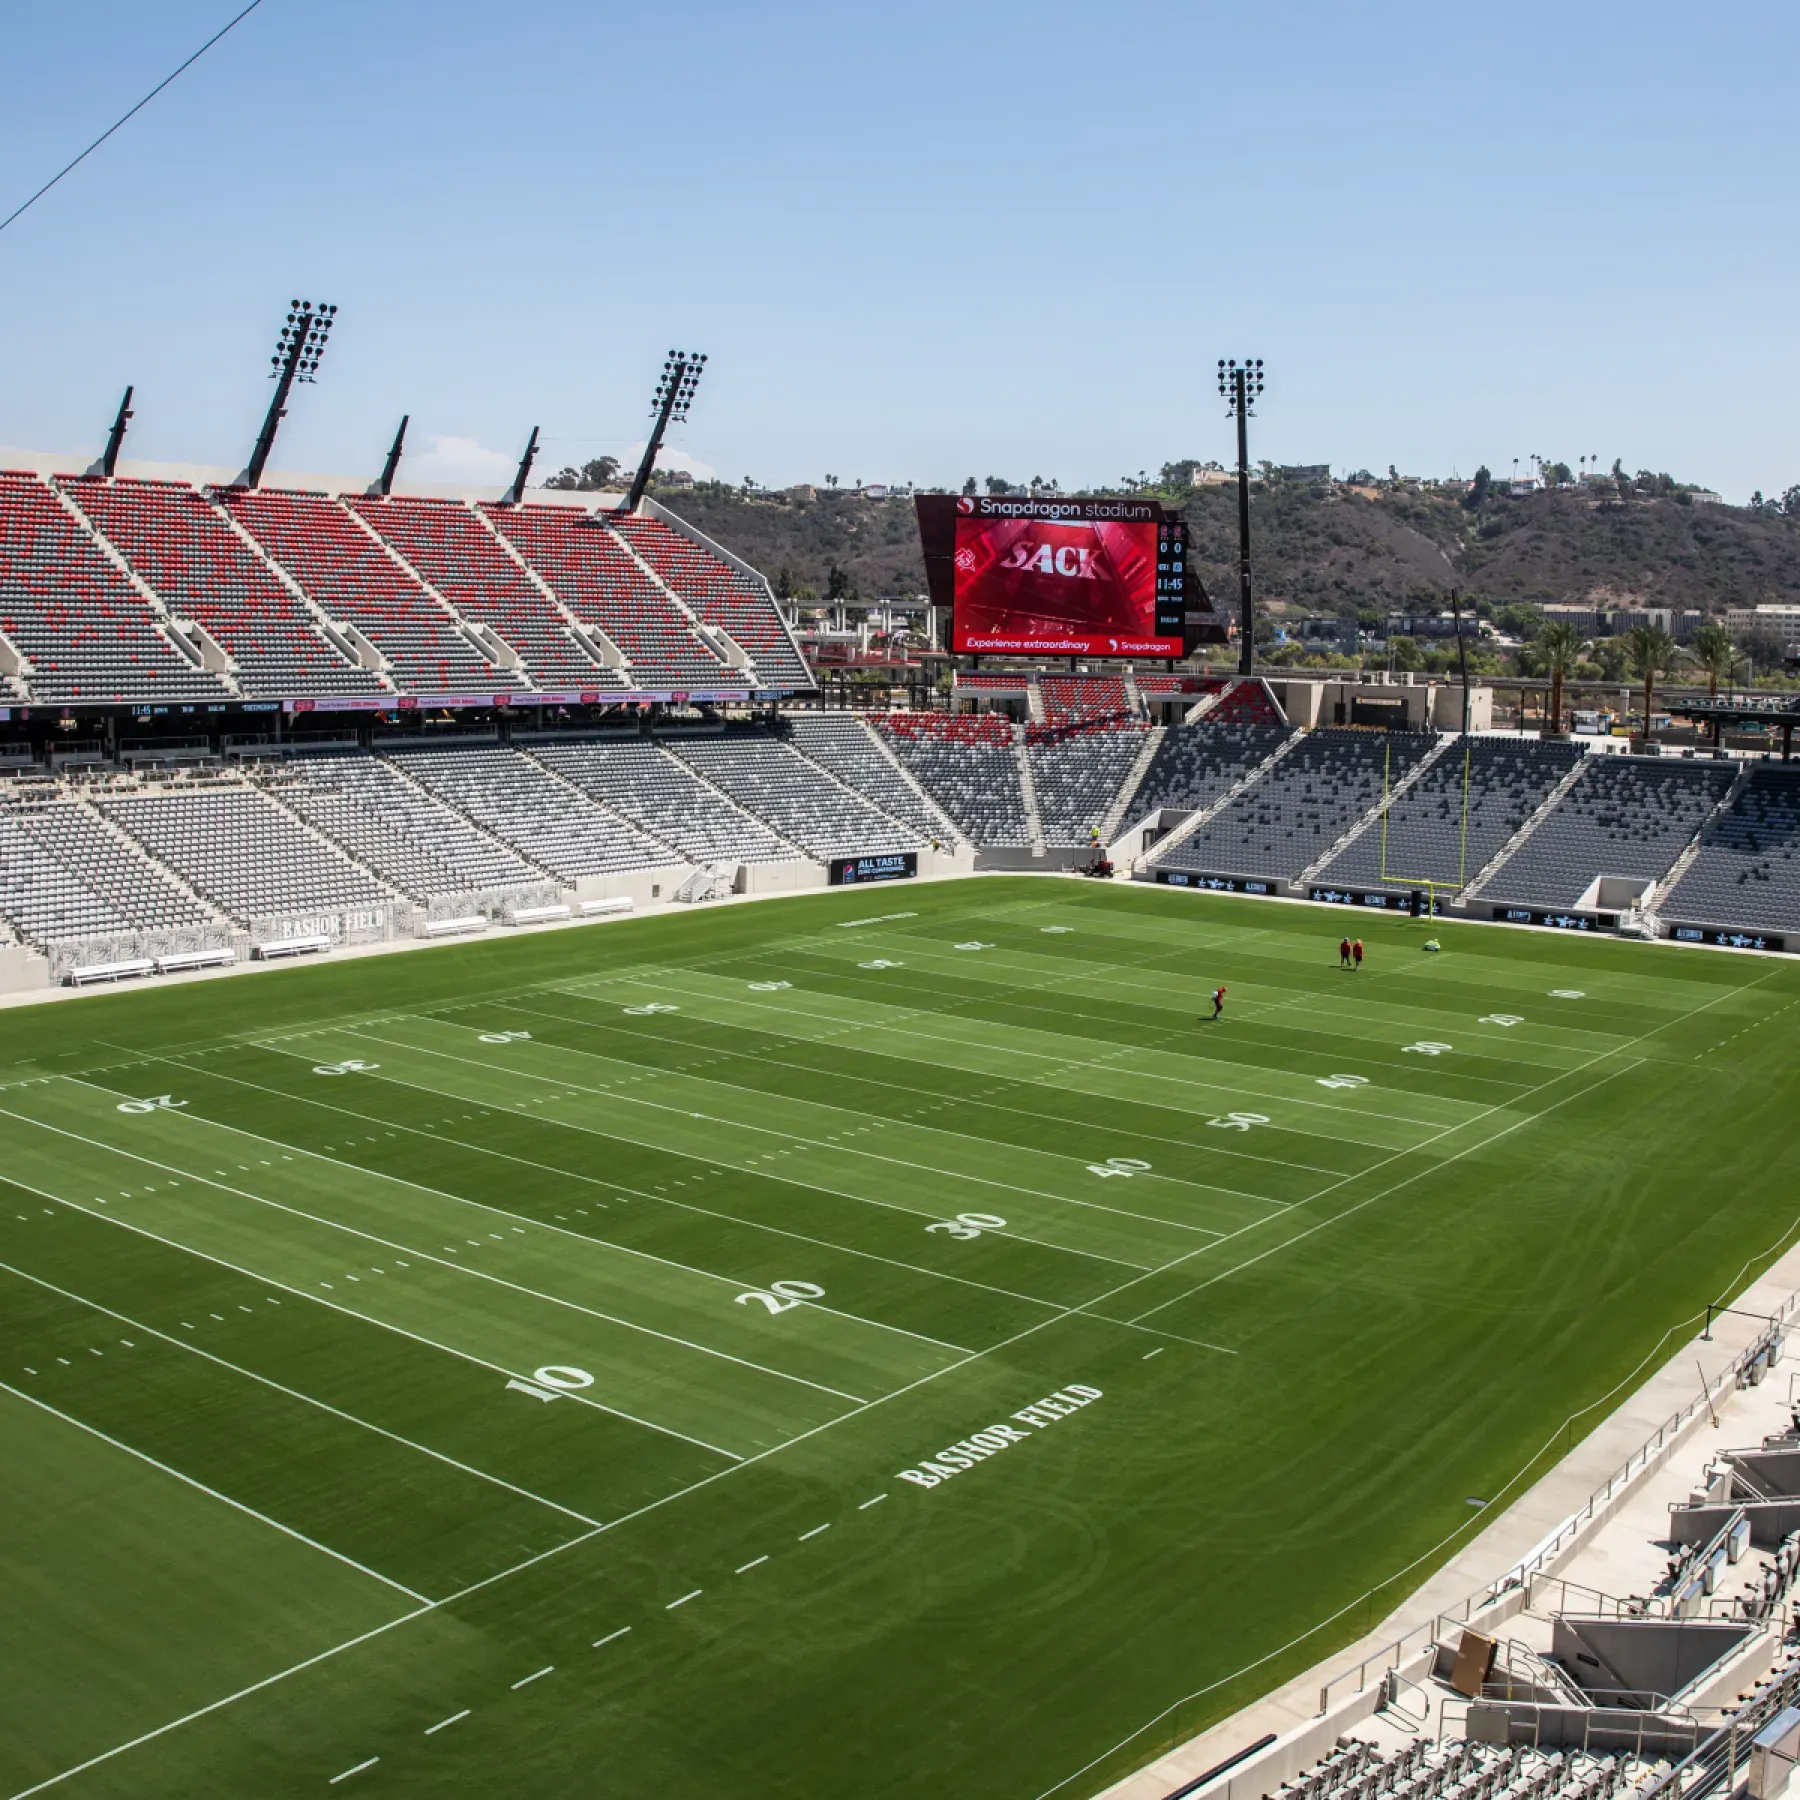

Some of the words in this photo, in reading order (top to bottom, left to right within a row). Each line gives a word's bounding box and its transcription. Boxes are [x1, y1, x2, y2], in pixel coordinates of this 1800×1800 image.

[980, 498, 1081, 518] Snapdragon
[1085, 502, 1151, 518] stadium
[1160, 542, 1168, 553] 0
[1000, 541, 1102, 579] SACK
[1157, 578, 1183, 590] 11:45
[966, 637, 1021, 649] Experience
[1023, 639, 1090, 651] extraordinary
[1121, 641, 1171, 651] Snapdragon
[858, 859, 875, 869] ALL
[283, 915, 341, 938] BASHOR
[345, 909, 384, 931] FIELD
[1401, 1041, 1453, 1056] 30
[1315, 1074, 1369, 1088] 40
[117, 1094, 189, 1113] 20
[1205, 1112, 1270, 1132] 50
[1086, 1158, 1152, 1177] 40
[924, 1213, 1008, 1240] 30
[734, 1280, 826, 1315] 20
[505, 1365, 595, 1403] 10
[894, 1424, 1032, 1489] BASHOR
[1009, 1384, 1103, 1429] FIELD
